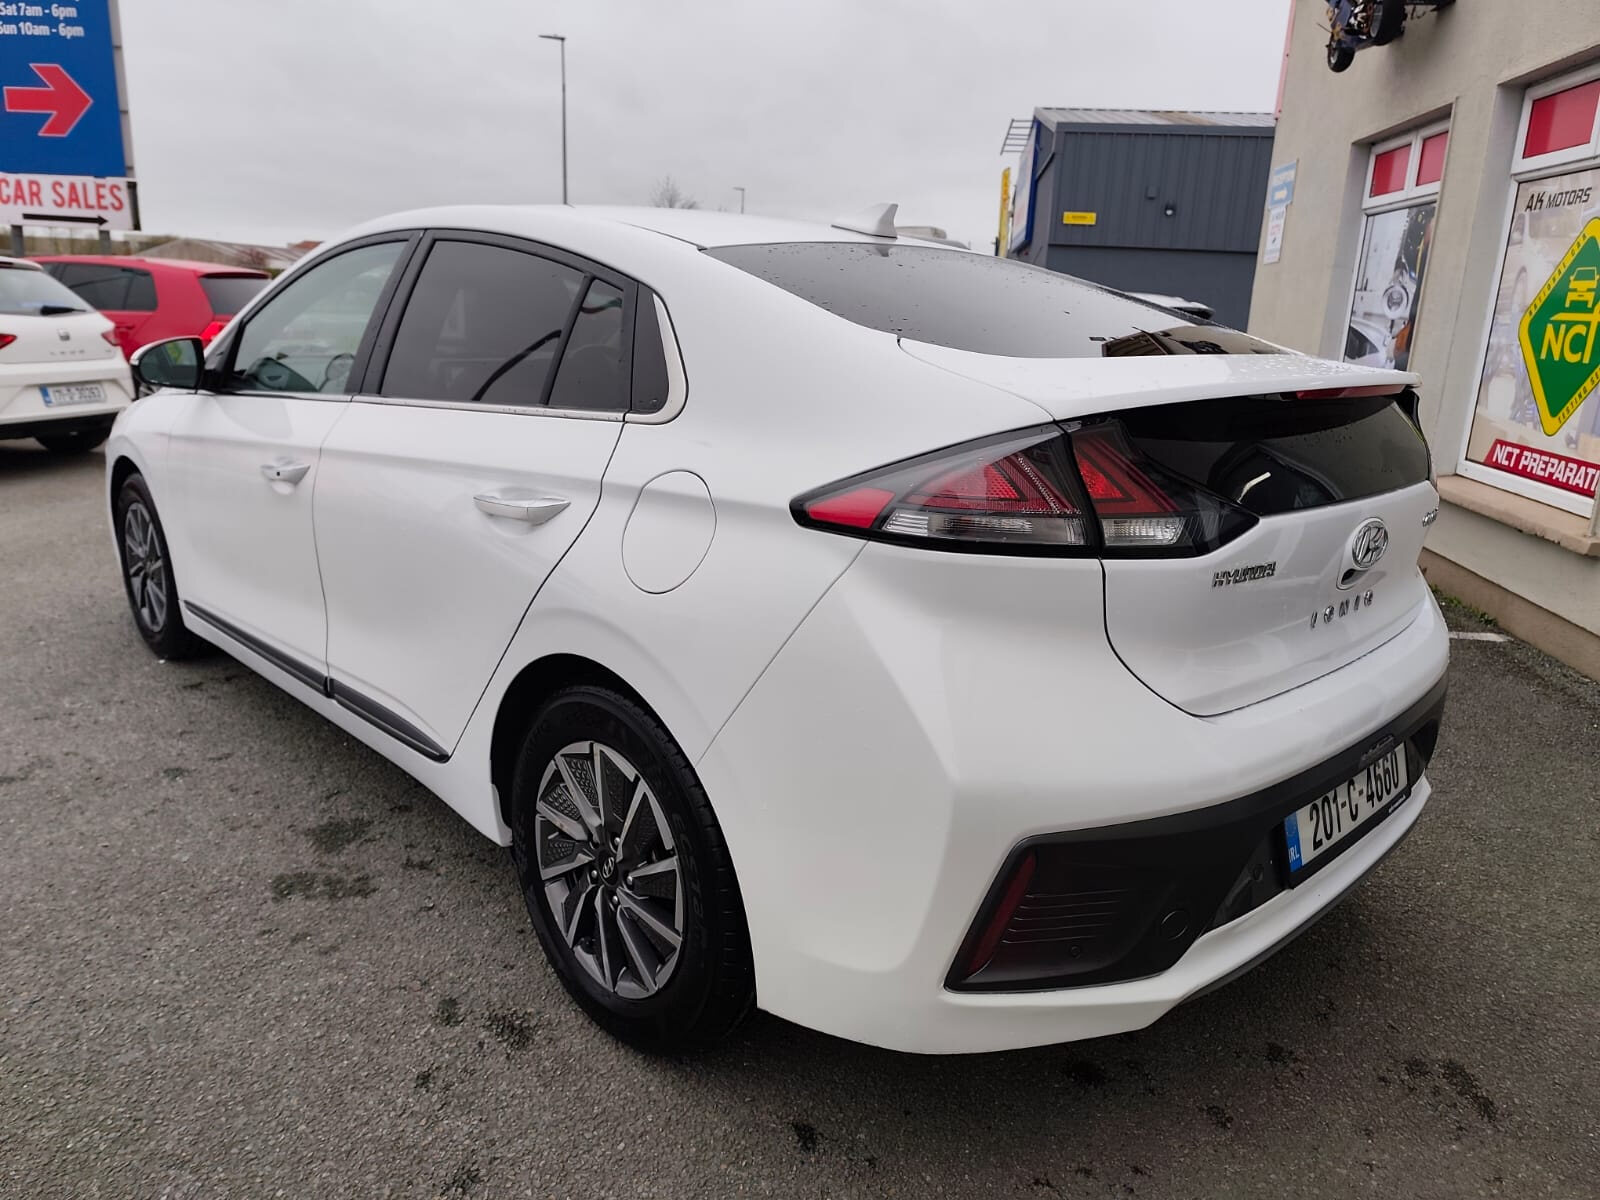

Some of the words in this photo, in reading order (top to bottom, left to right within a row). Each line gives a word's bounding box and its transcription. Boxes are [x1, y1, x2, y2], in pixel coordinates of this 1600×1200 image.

[0, 2, 18, 16] Sat
[18, 2, 43, 17] 7am
[51, 3, 77, 20] 6pm
[19, 21, 50, 36] 10am
[58, 22, 85, 39] 6pm
[0, 178, 42, 207] CAR
[51, 180, 124, 212] SALES
[1524, 191, 1546, 212] AK
[1545, 187, 1593, 209] MOTORS
[1540, 314, 1600, 364] NCT
[1492, 443, 1520, 468] NCT
[1288, 846, 1300, 864] IRL
[1309, 751, 1400, 851] 201-C-4660
